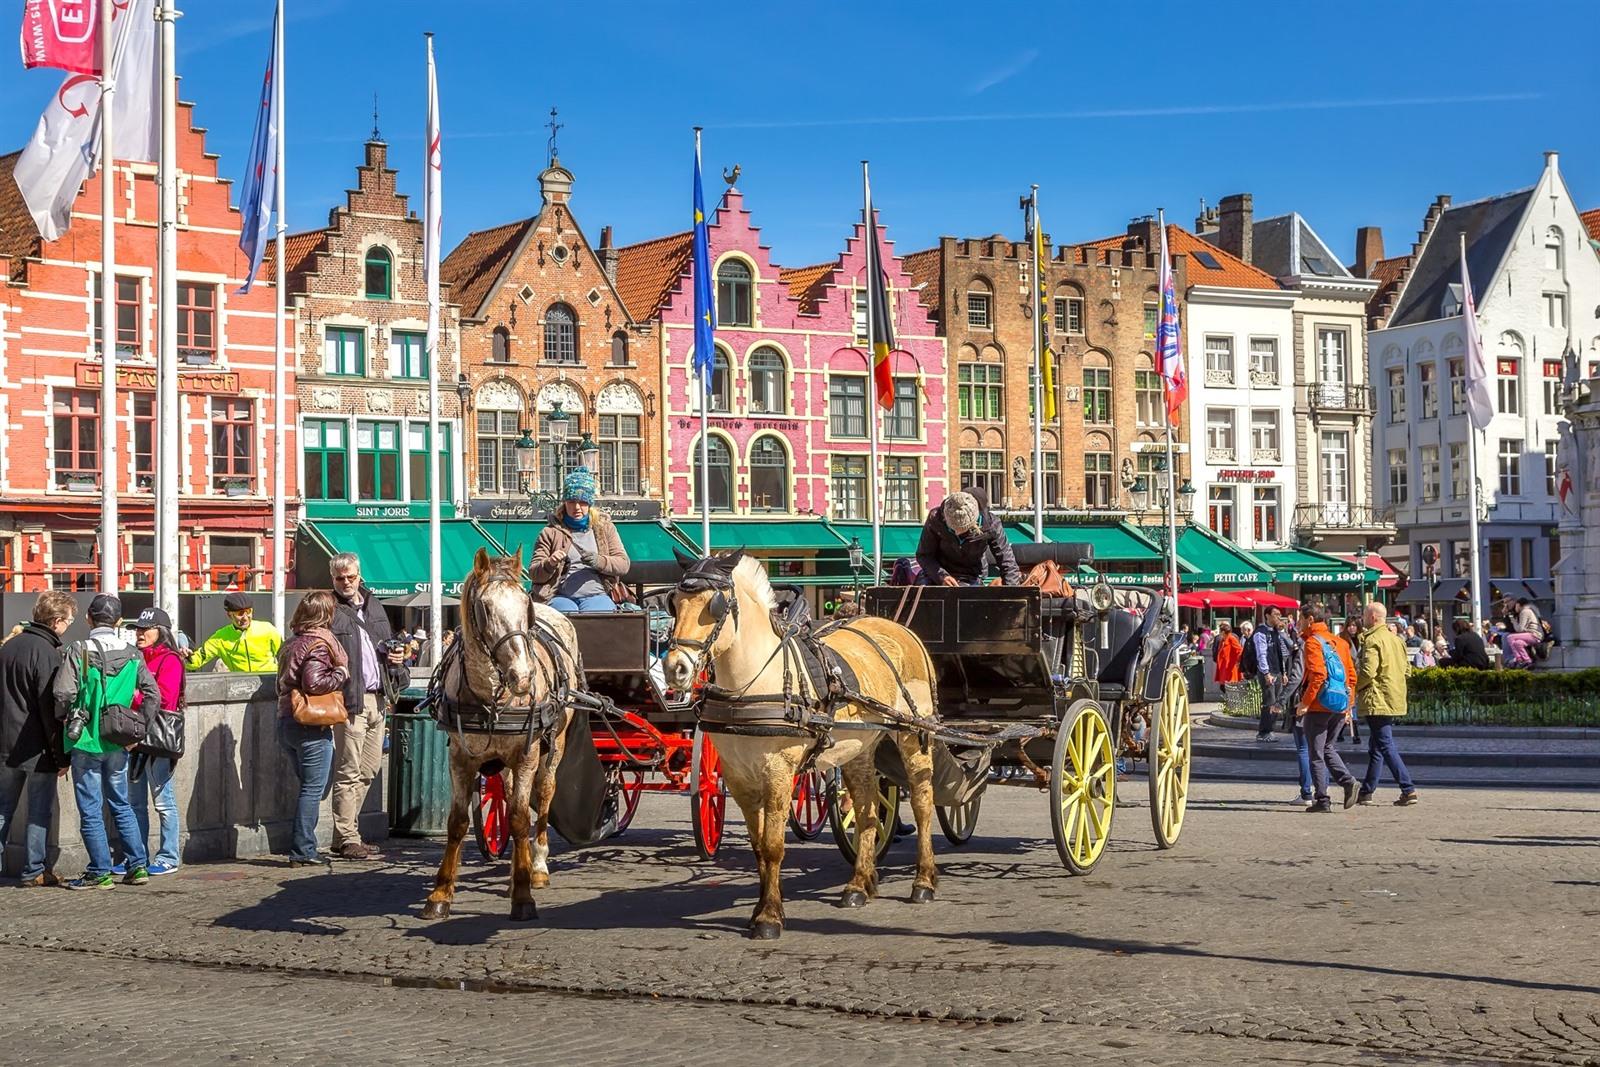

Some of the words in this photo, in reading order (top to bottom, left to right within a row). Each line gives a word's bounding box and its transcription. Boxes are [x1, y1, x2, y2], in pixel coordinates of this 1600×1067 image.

[356, 507, 380, 517] SINT
[382, 507, 410, 517] JORIS
[1214, 573, 1236, 582] PETIT
[1293, 573, 1333, 581] Friterie
